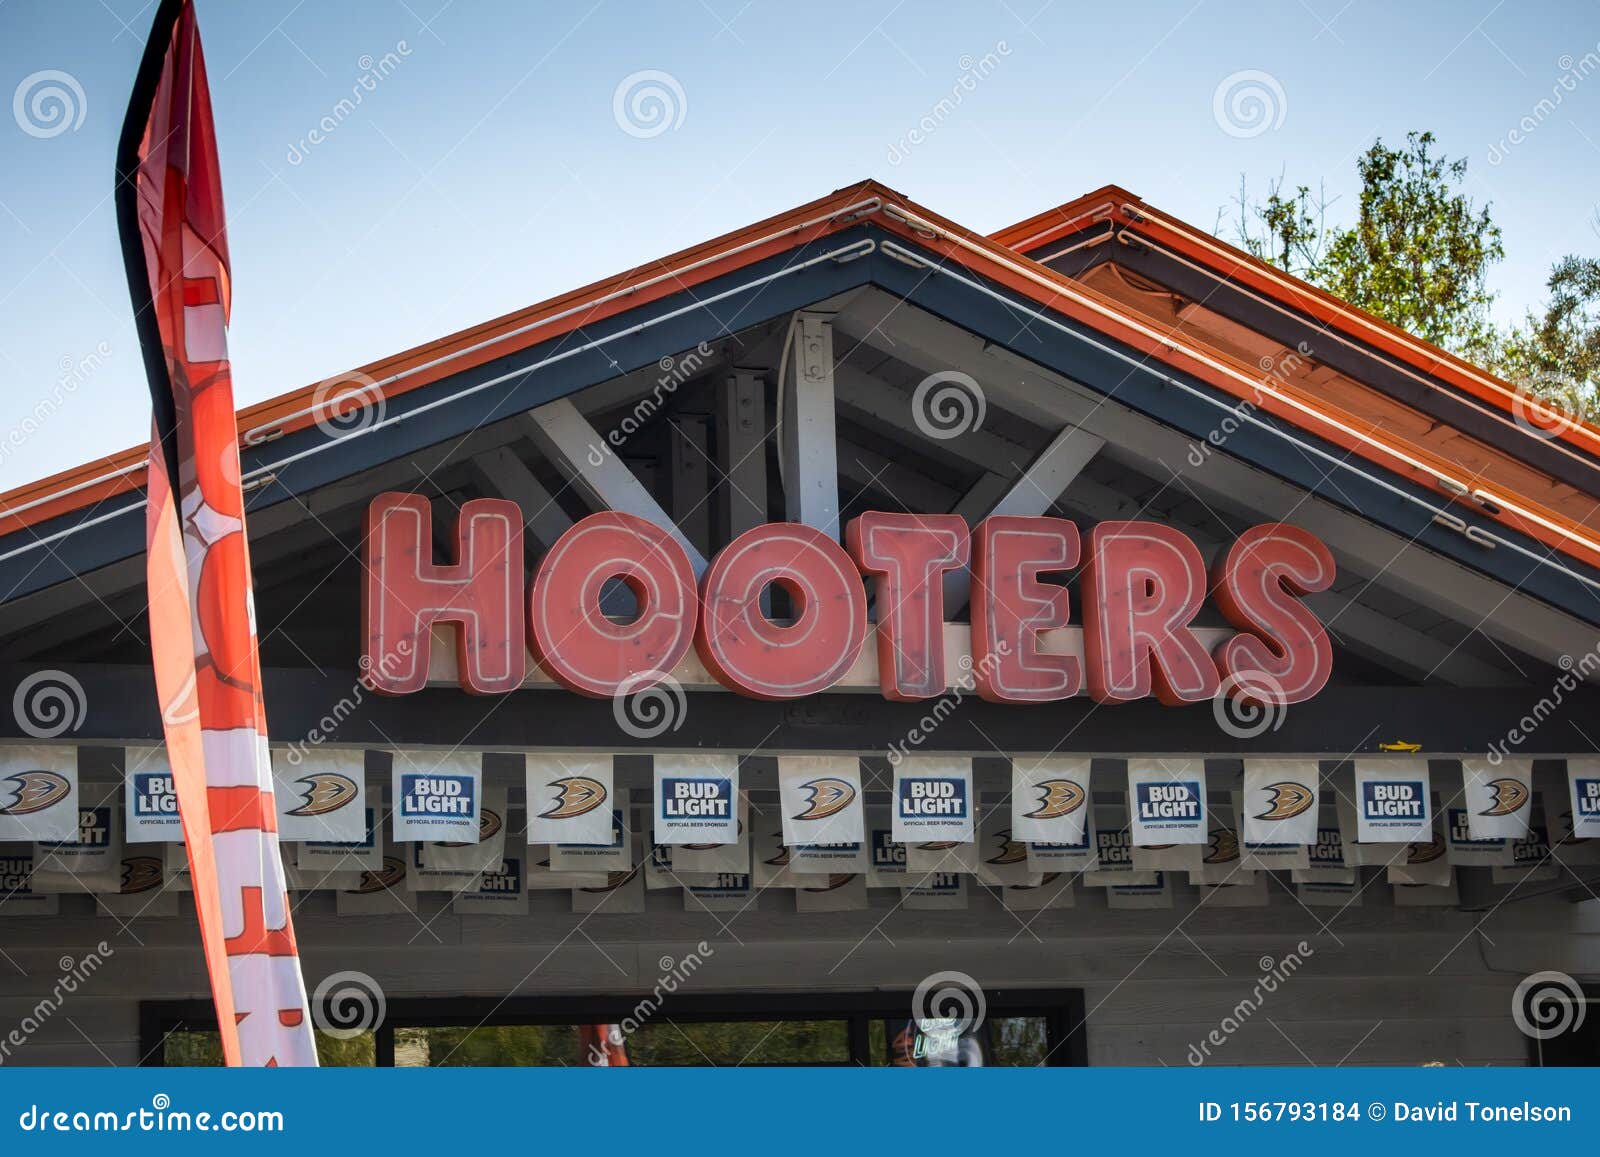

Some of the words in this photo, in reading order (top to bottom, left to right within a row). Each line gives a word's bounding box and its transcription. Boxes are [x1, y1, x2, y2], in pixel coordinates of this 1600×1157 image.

[360, 491, 1336, 706] HOOTERS
[148, 777, 177, 795] BU
[414, 778, 462, 796] BUD
[675, 782, 719, 799] BUD
[910, 782, 955, 798] BUD
[1148, 786, 1189, 802] BUD
[1374, 785, 1413, 801] BUD
[139, 795, 180, 812] LIG
[405, 795, 471, 814] LIGHT
[666, 799, 728, 816] LIGHT
[902, 798, 963, 815] LIGHT
[1141, 801, 1198, 818] LIGHT
[1367, 800, 1421, 816] LIGHT
[1318, 831, 1341, 845] UD
[876, 847, 907, 863] LIG
[1098, 847, 1132, 861] IGH
[0, 875, 33, 890] IGH
[482, 876, 517, 890] GHT
